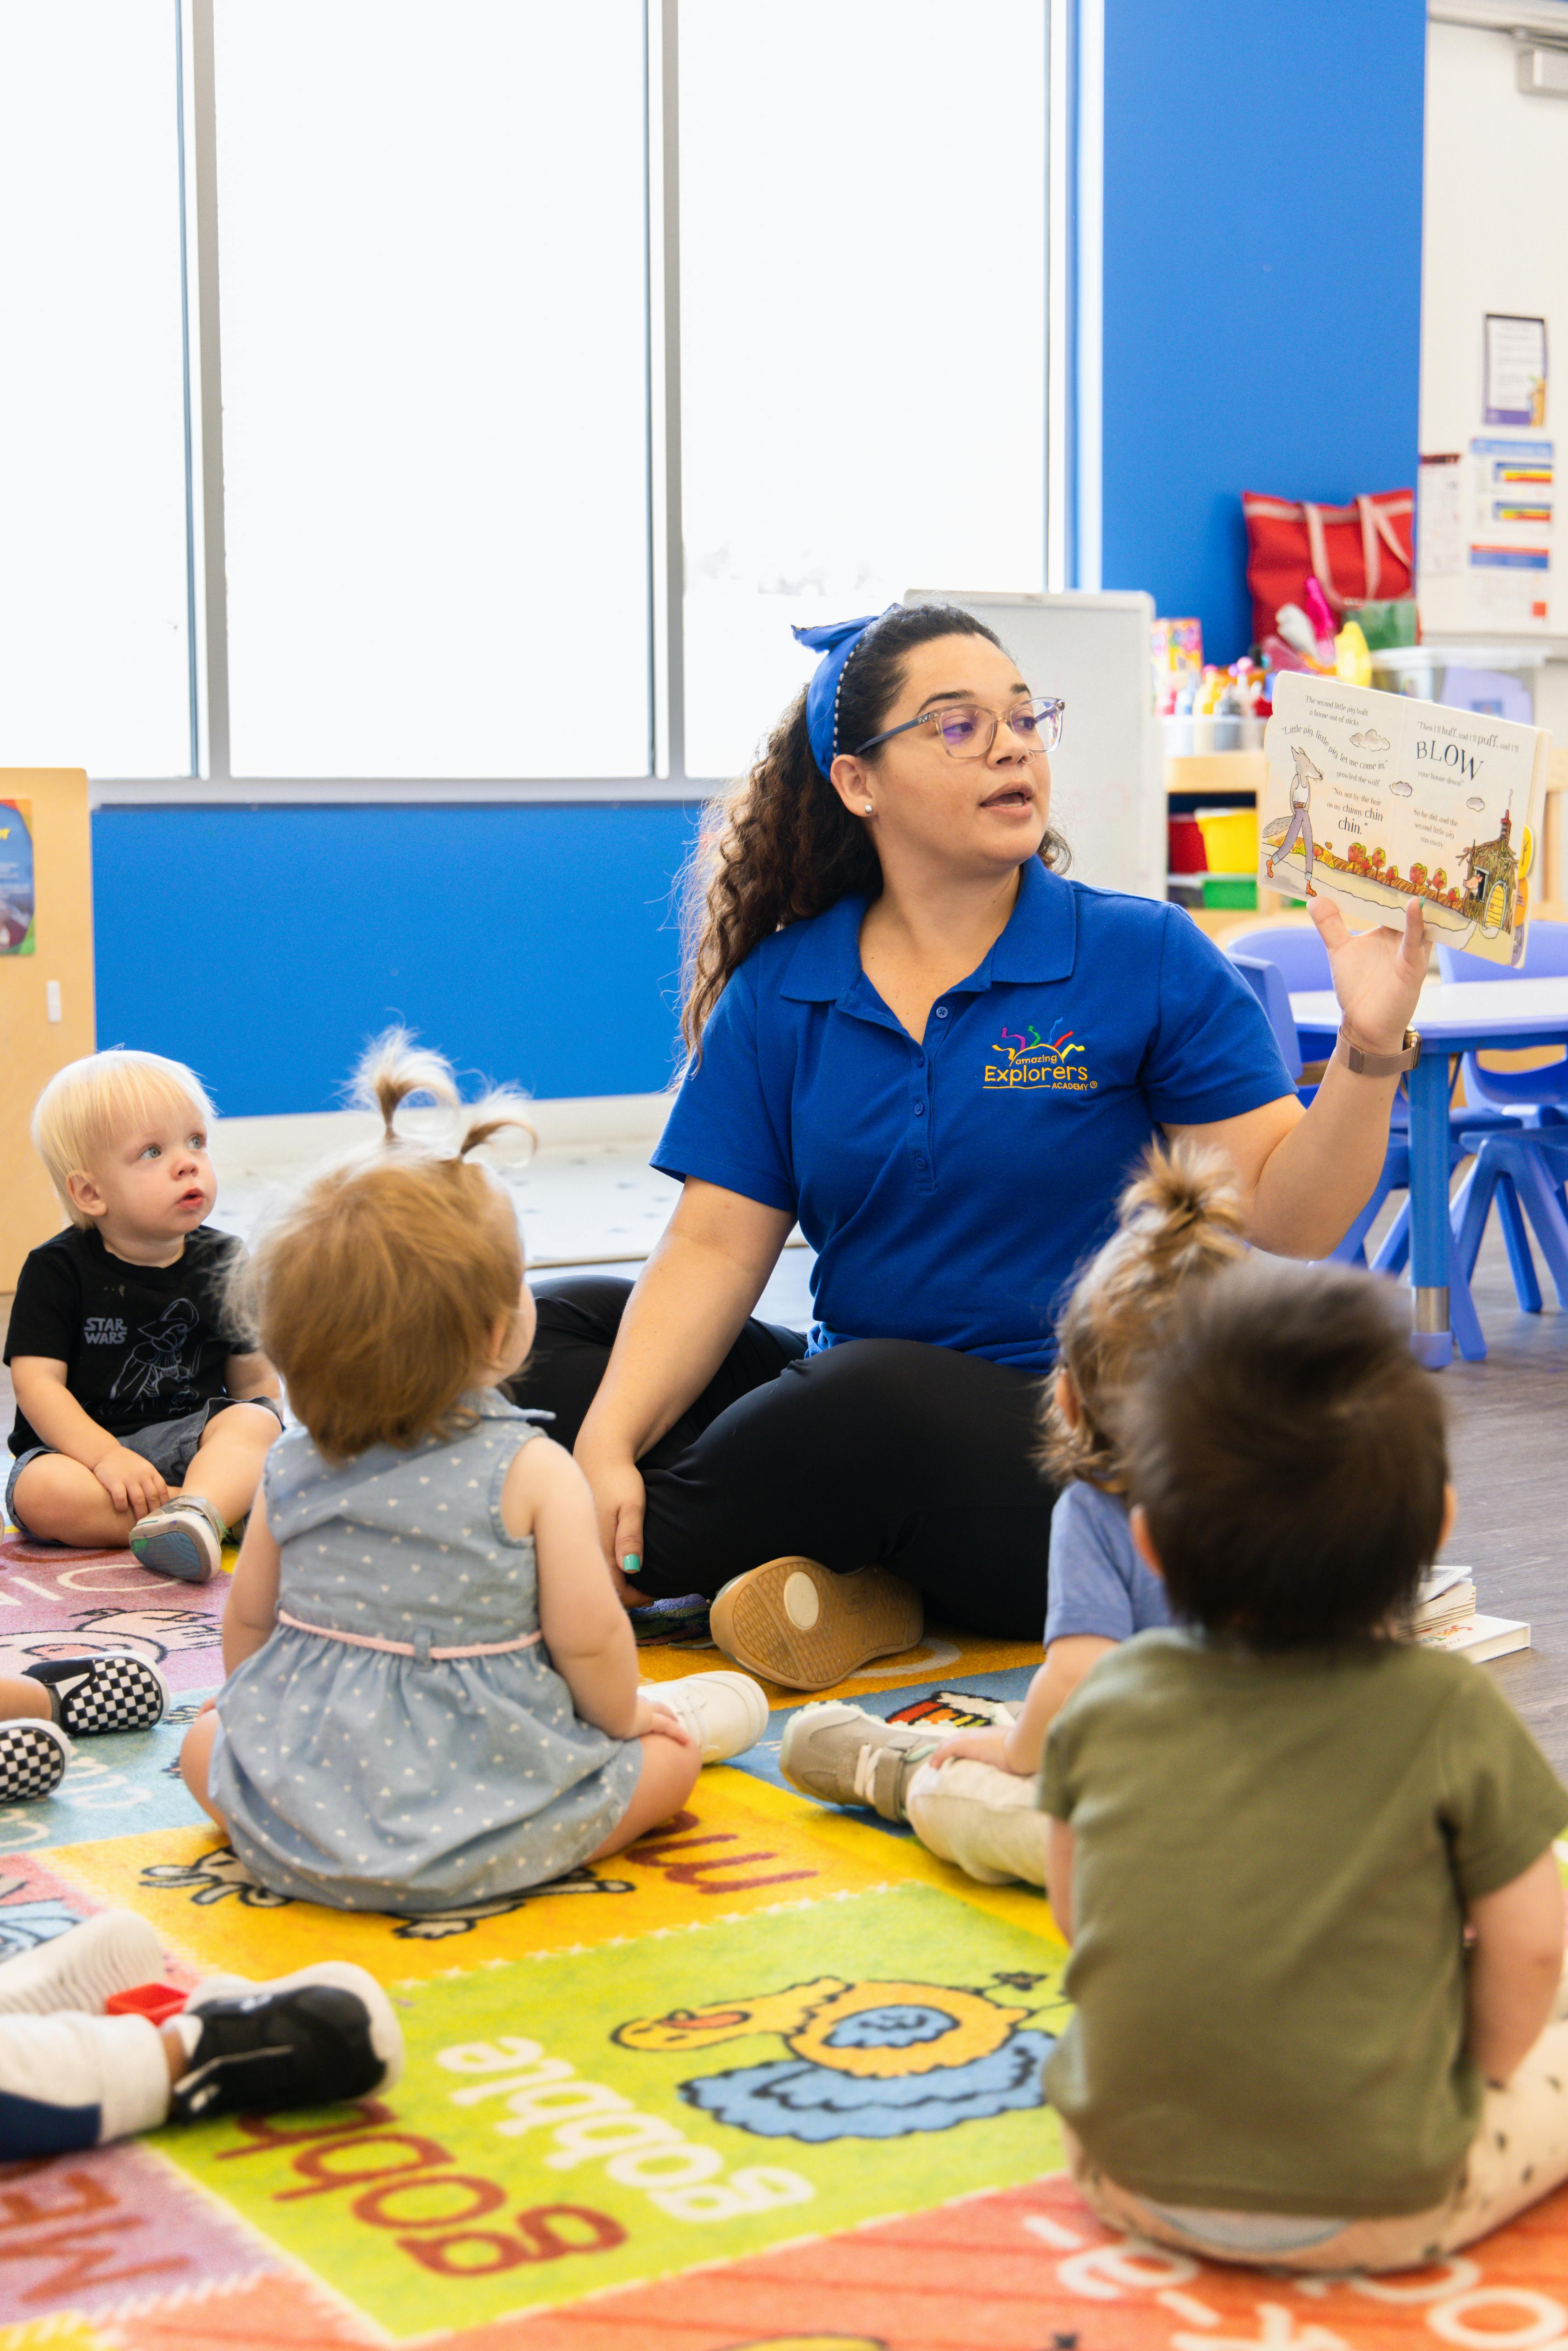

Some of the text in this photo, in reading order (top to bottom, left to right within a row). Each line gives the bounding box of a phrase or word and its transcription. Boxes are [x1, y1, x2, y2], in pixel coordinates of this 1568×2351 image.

[1305, 695, 1368, 716] The second little pig built
[1314, 709, 1328, 719] house
[1315, 730, 1329, 747] little
[1340, 753, 1348, 764] let
[1416, 740, 1484, 781] BLOW
[1336, 771, 1357, 781] growled
[1430, 772, 1445, 782] house
[1354, 793, 1360, 802] by
[1361, 795, 1370, 803] the
[1371, 797, 1382, 806] hair
[1343, 804, 1363, 818] chinny
[1365, 808, 1383, 822] chin
[1450, 819, 1458, 827] the
[1415, 823, 1454, 841] second little pig
[1015, 1054, 1057, 1065] amazing
[984, 1064, 1088, 1086] Explorers
[1052, 1082, 1088, 1091] ACADEMY
[84, 1317, 128, 1331] STAR
[84, 1331, 127, 1344] WARS
[435, 2036, 816, 2222] gobble
[214, 2103, 629, 2278] gobb
